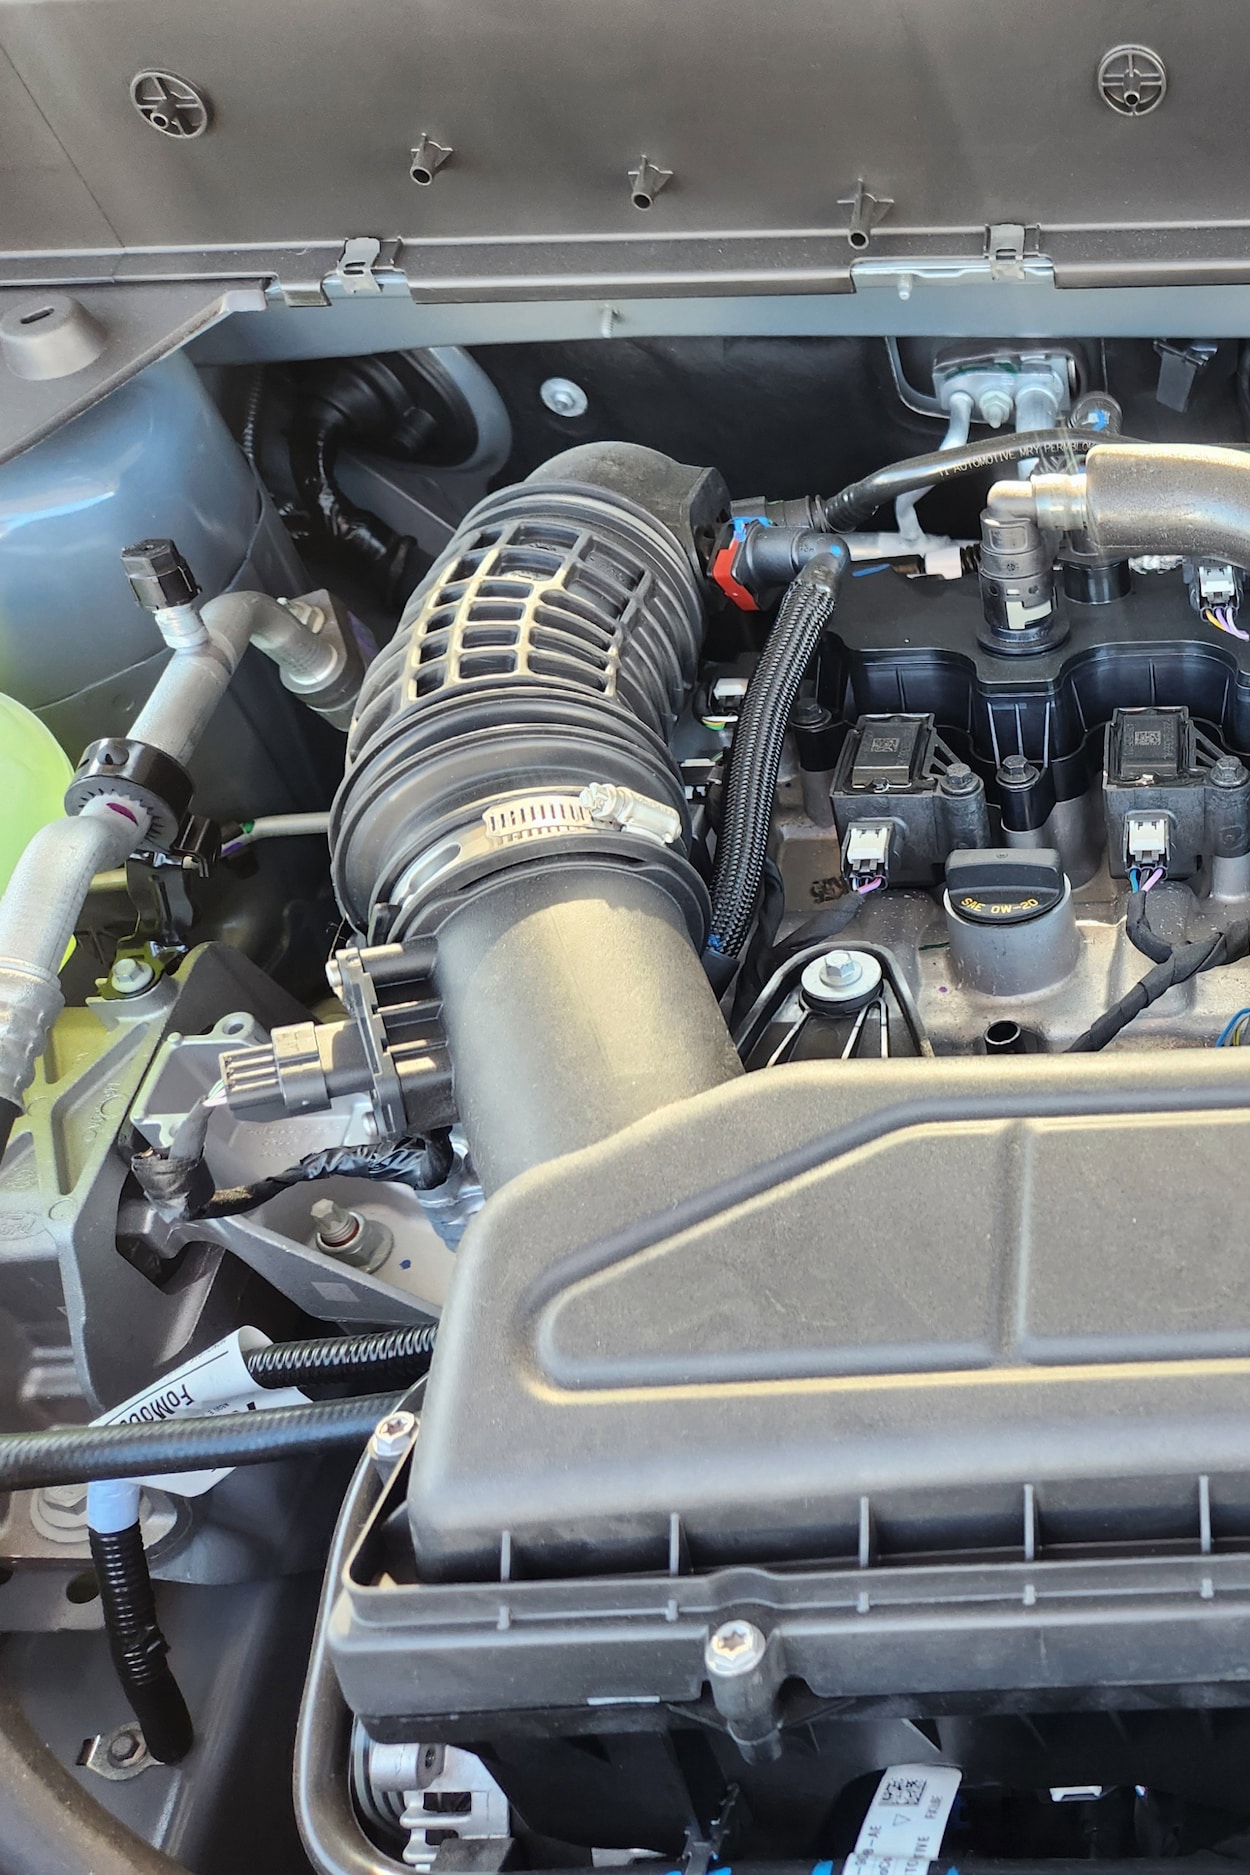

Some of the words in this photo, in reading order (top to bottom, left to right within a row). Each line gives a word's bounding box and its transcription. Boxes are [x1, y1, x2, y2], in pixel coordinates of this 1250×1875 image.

[953, 452, 1016, 473] AUTOMOTIVE
[961, 897, 986, 912] SAE
[990, 898, 1039, 914] 0W-20
